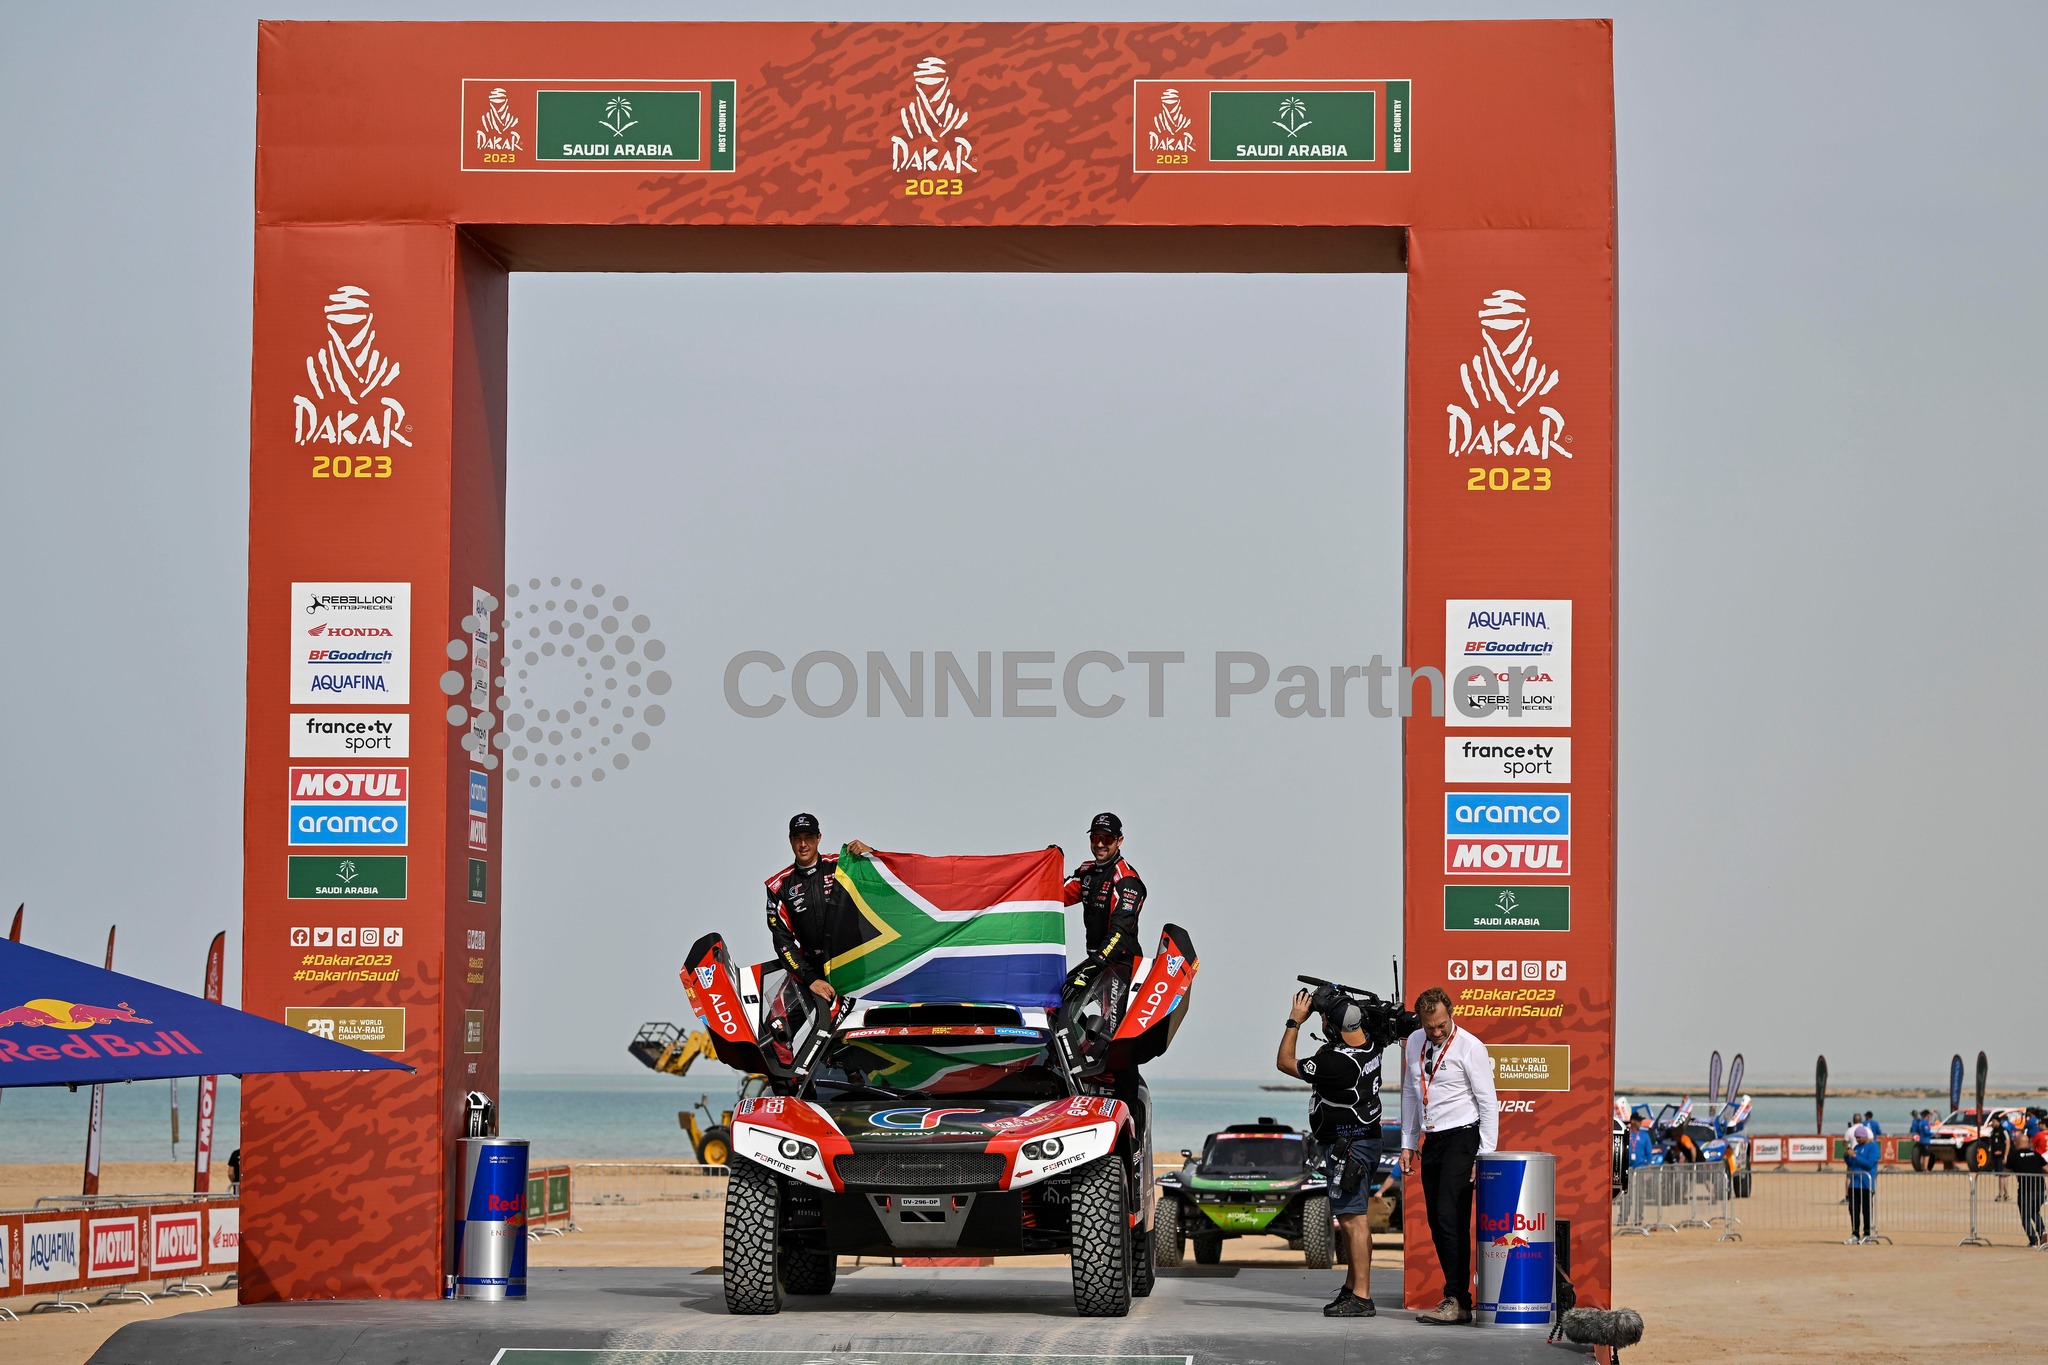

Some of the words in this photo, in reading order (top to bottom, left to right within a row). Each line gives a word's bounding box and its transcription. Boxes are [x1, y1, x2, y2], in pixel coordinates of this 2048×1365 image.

[718, 99, 727, 129] COUNTRY
[1393, 99, 1402, 129] COUNTRY
[476, 129, 523, 152] DAKAR
[562, 143, 610, 157] SAUDI
[613, 143, 673, 157] ARABIA
[718, 129, 727, 153] HOST
[1148, 130, 1195, 153] DAKAR
[1393, 130, 1402, 153] HOST
[483, 153, 517, 163] 2023
[891, 137, 977, 174] DAKAR
[1156, 154, 1189, 164] 2023
[1236, 144, 1284, 158] SAUDI
[1287, 144, 1348, 158] ARABIA
[904, 178, 964, 196] 2023
[293, 394, 412, 449] DAKAR
[1446, 403, 1573, 460] DAKAR
[312, 455, 393, 479] 2023
[1467, 467, 1552, 491] 2023
[321, 595, 394, 604] REBELLION
[1467, 611, 1548, 630] AQUAFINA
[327, 627, 394, 637] HONDA
[308, 649, 393, 661] BFGoodrich
[1465, 641, 1554, 652] BFGoodrich
[310, 674, 387, 693] AQUAFINA
[345, 735, 391, 753] sport
[1503, 760, 1552, 778] sport
[296, 773, 401, 797] MOTUL
[1455, 805, 1560, 824] aramco
[298, 815, 398, 834] aramco
[470, 819, 486, 844] MOTUL
[1452, 844, 1563, 868] MOTUL
[315, 886, 343, 895] SAUDI
[344, 886, 379, 895] ARABIA
[1123, 888, 1138, 896] ALDO
[1473, 917, 1502, 926] SAUDI
[1504, 918, 1540, 926] ARABIA
[301, 954, 393, 966] #Dakar2023
[293, 969, 400, 982] #DakarInSaudi
[1459, 988, 1556, 1001] #Dakar2023
[708, 992, 737, 1035] ALDO
[1136, 981, 1168, 1028] ALDO
[1453, 1004, 1564, 1017] #DakarInSaudi
[338, 1026, 384, 1034] RALLY-RAID
[849, 1029, 888, 1037] MOTUL
[0, 1034, 102, 1062] Red
[90, 1030, 203, 1057] Bull
[1500, 1064, 1548, 1072] RALLY-RAID
[754, 1151, 796, 1173] FORTINET
[1042, 1152, 1087, 1173] FORTINET
[488, 1194, 520, 1211] Red
[1480, 1213, 1510, 1231] Red
[1513, 1213, 1546, 1231] Bull
[30, 1231, 76, 1271] AQUAFINA
[94, 1230, 134, 1265] MOTUL
[157, 1224, 197, 1259] MOTUL
